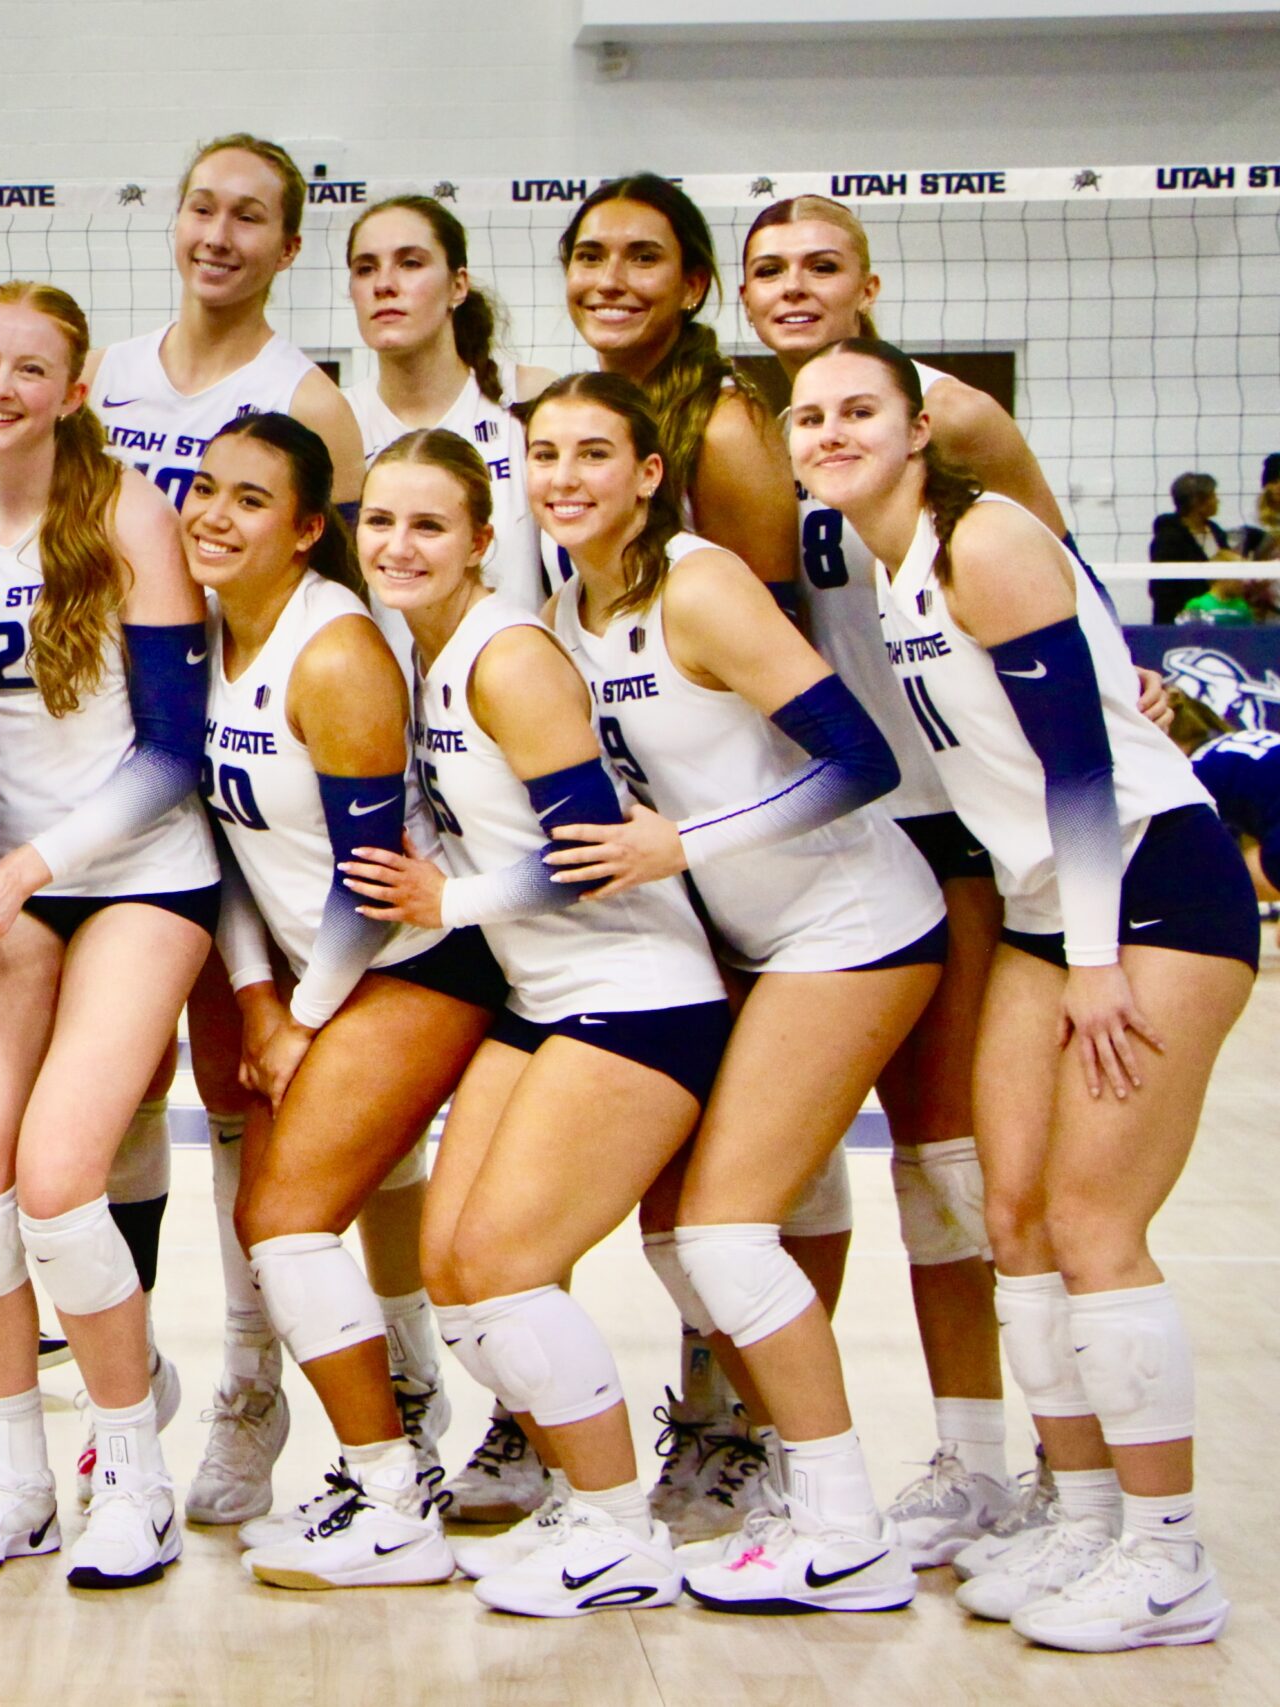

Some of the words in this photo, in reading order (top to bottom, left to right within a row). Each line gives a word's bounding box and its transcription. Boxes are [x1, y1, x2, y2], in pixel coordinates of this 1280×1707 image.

[512, 179, 587, 202] UTAH
[831, 174, 907, 197] UTAH
[920, 172, 1006, 194] STATE
[1156, 166, 1235, 189] UTAH
[307, 182, 367, 204] TATE
[105, 425, 167, 453] UTAH
[802, 508, 849, 590] 8
[904, 631, 952, 663] STATE
[602, 673, 660, 704] STATE
[903, 675, 961, 753] 11
[219, 726, 278, 755] STATE
